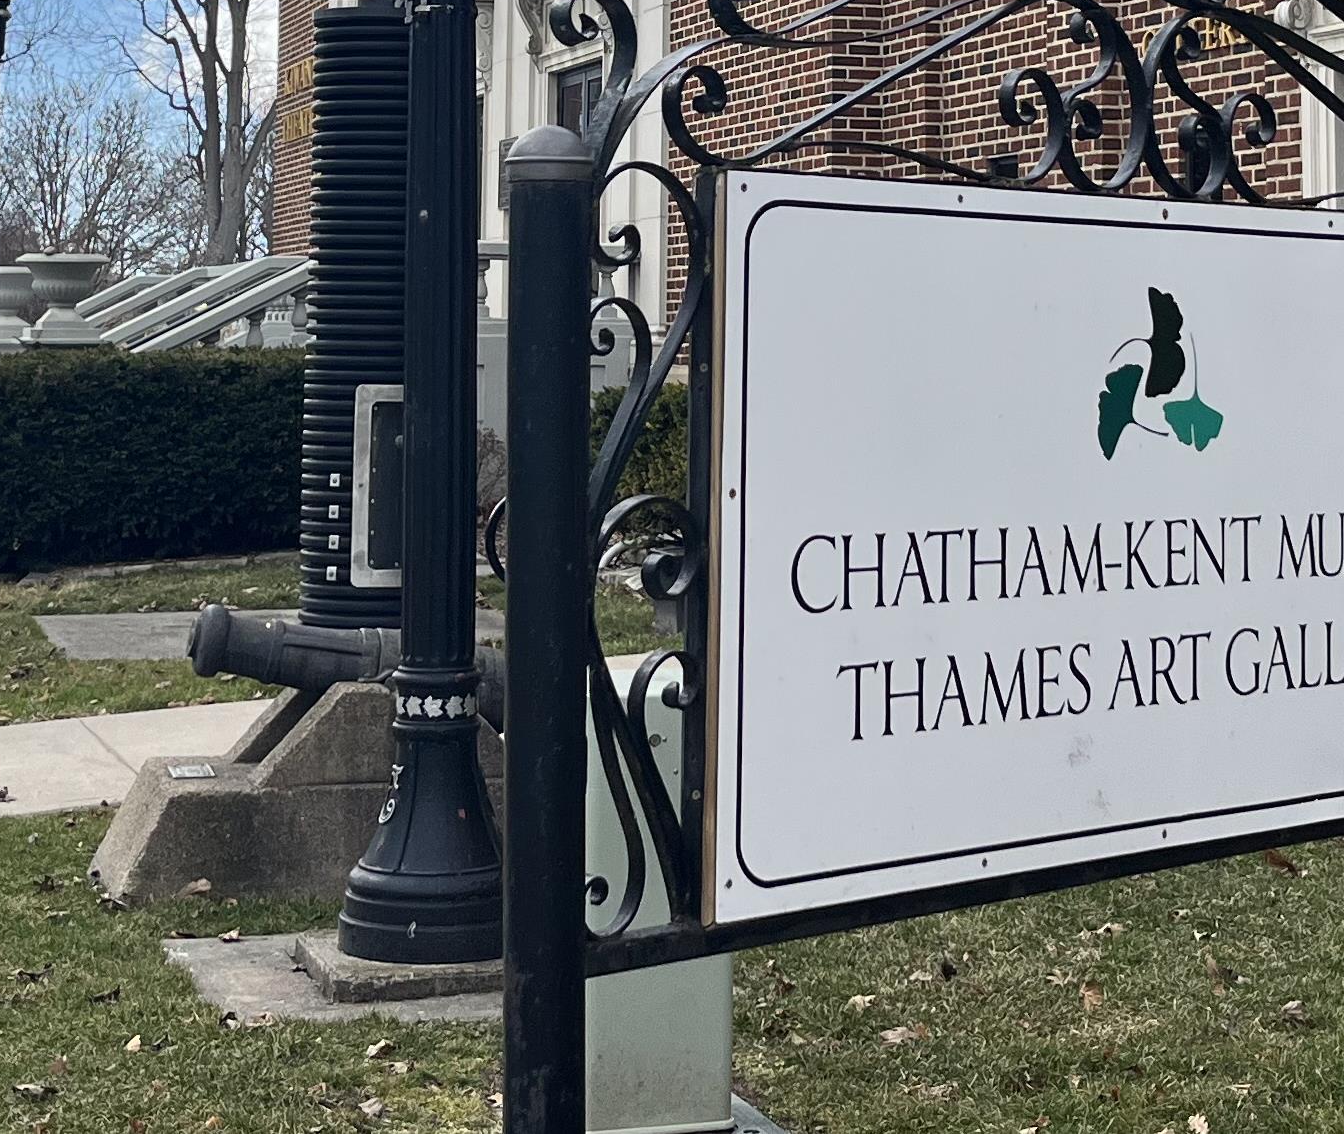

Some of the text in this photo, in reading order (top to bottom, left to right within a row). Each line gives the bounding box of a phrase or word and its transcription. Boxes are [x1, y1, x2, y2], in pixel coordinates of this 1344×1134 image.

[790, 515, 1261, 614] CHATHAM-KENT
[836, 643, 1092, 741] THAMES
[1108, 632, 1212, 710] ART
